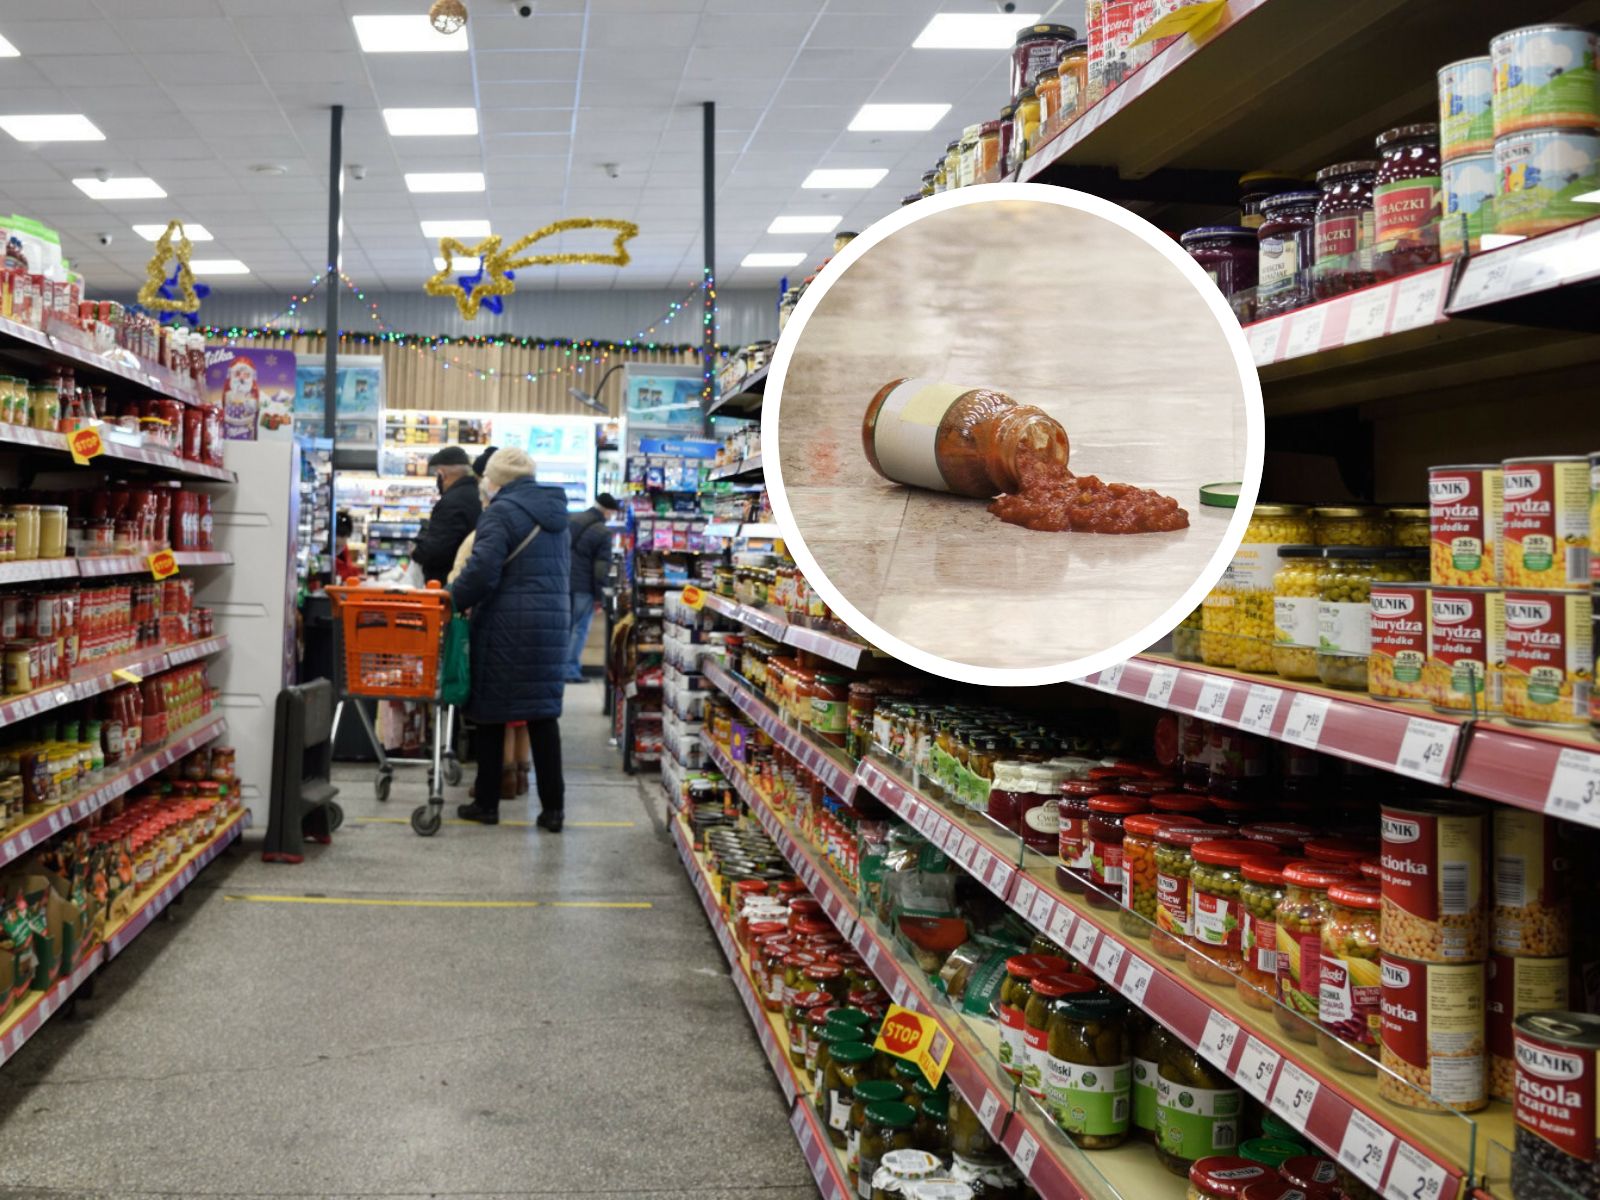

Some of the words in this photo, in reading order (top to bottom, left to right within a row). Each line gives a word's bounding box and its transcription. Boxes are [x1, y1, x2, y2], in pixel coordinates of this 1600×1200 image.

[1504, 162, 1541, 193] ids
[76, 435, 101, 454] STOP
[1505, 604, 1543, 619] OLNIK
[885, 1021, 920, 1045] STOP
[1518, 1092, 1570, 1120] czarna
[1362, 1143, 1384, 1164] 299
[1412, 1175, 1439, 1200] 299
